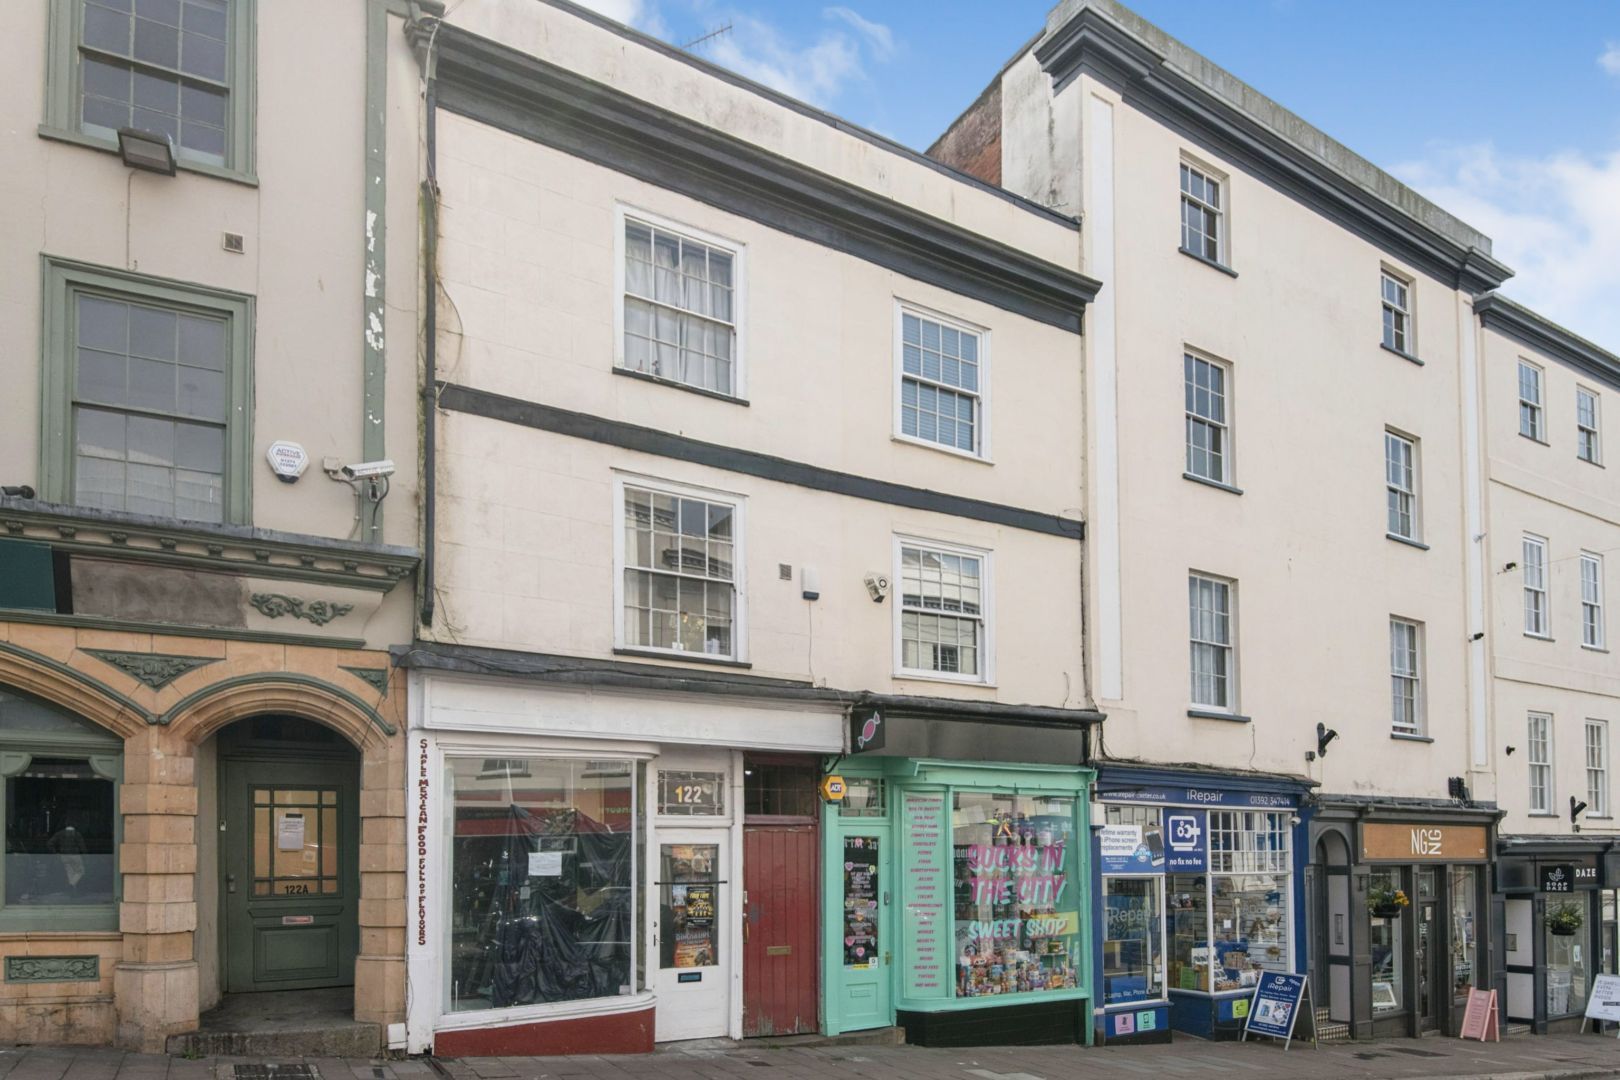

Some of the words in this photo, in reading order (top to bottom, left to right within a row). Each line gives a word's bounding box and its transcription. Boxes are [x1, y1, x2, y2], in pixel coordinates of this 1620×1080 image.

[420, 739, 428, 777] SIMPLE
[419, 779, 429, 823] MEXICAN
[1186, 788, 1223, 803] iRepair
[418, 826, 427, 855] FOOD
[968, 844, 1039, 874] SUCKS
[1040, 845, 1066, 872] IN
[1575, 868, 1597, 878] DAZE
[285, 884, 309, 895] 122A
[419, 883, 425, 895] OF
[969, 875, 1015, 906] THE
[1018, 874, 1067, 905] CITY
[418, 896, 426, 946] FLAVOURS
[968, 919, 1024, 940] SWEET
[1026, 918, 1068, 938] SHOP
[1268, 983, 1292, 992] iRepair
